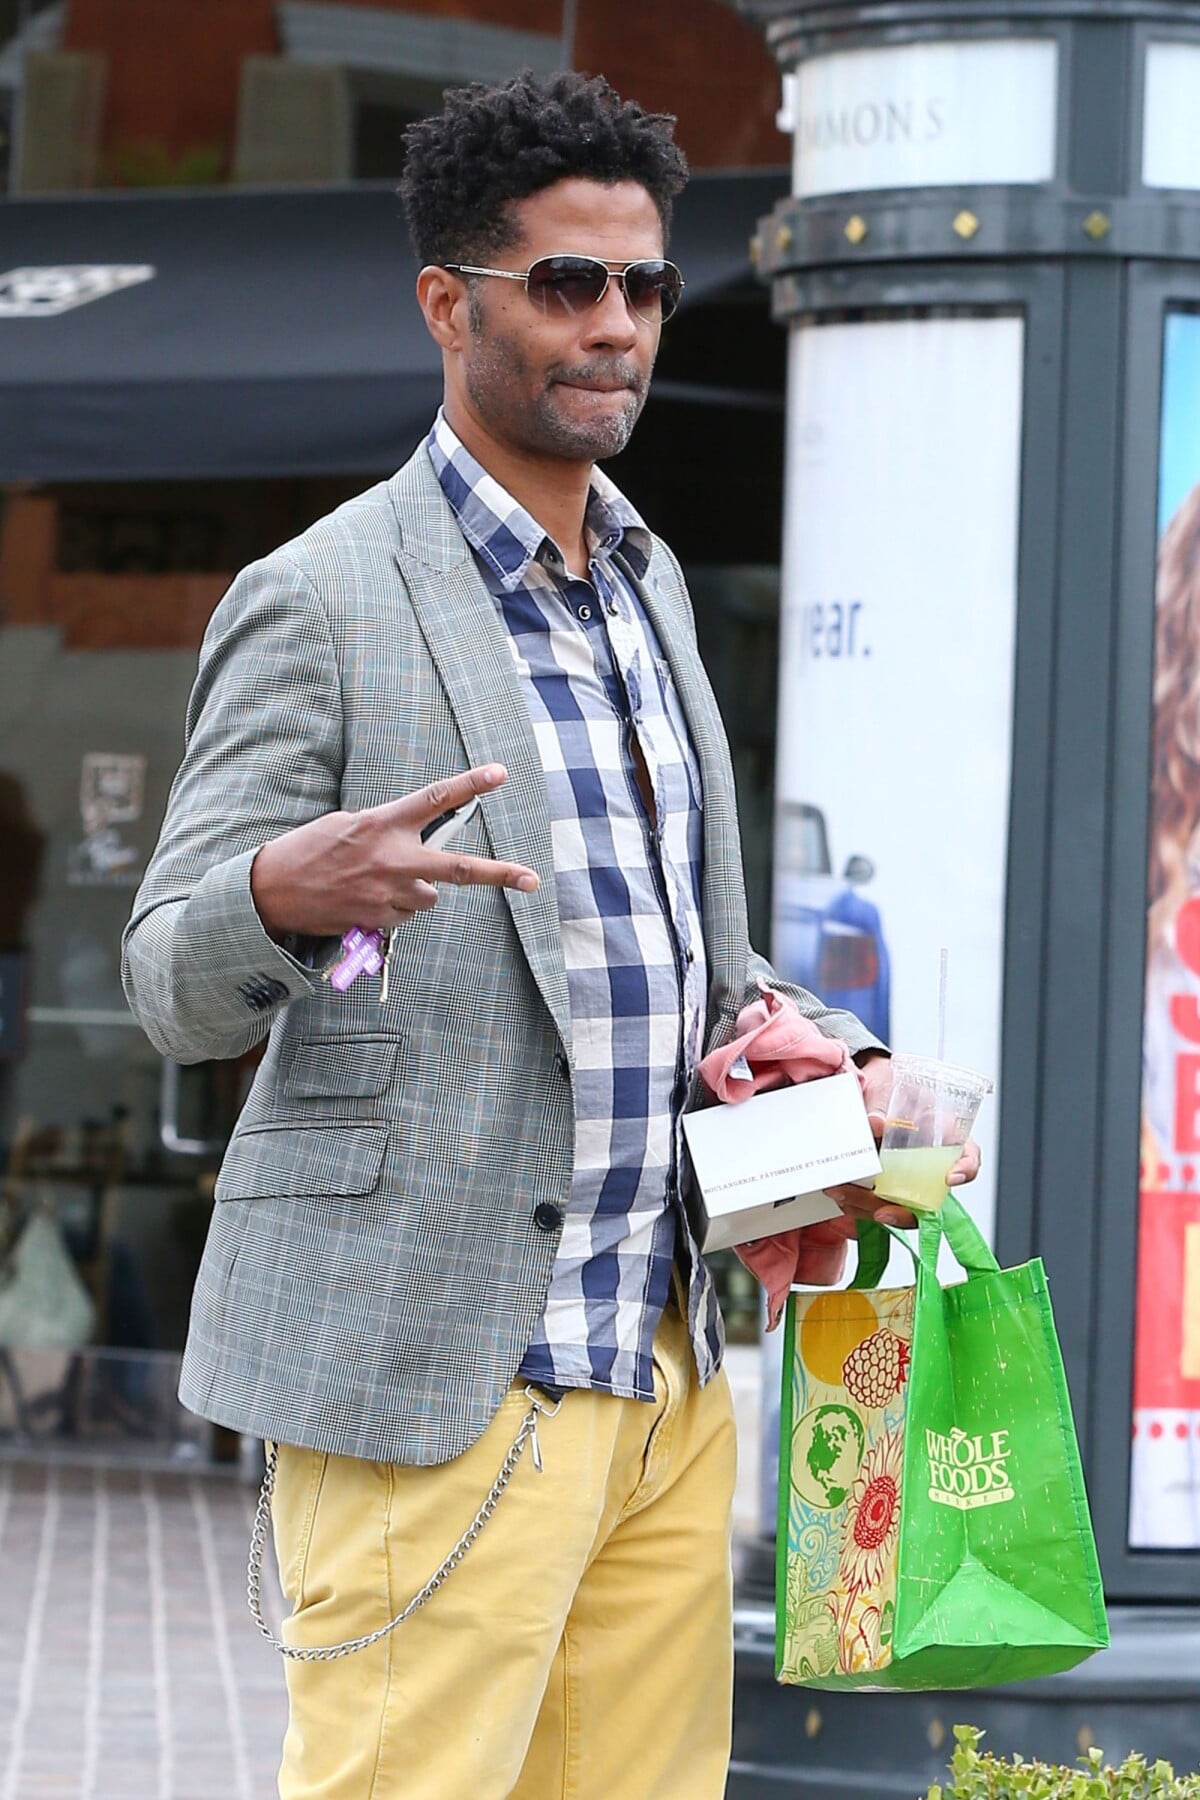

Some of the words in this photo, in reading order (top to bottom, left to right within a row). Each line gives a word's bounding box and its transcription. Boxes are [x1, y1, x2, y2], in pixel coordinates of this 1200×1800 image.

[805, 1160, 815, 1169] ET
[816, 1155, 839, 1166] TABLE
[925, 1427, 1012, 1467] WHOLE
[928, 1459, 1009, 1496] FOODS
